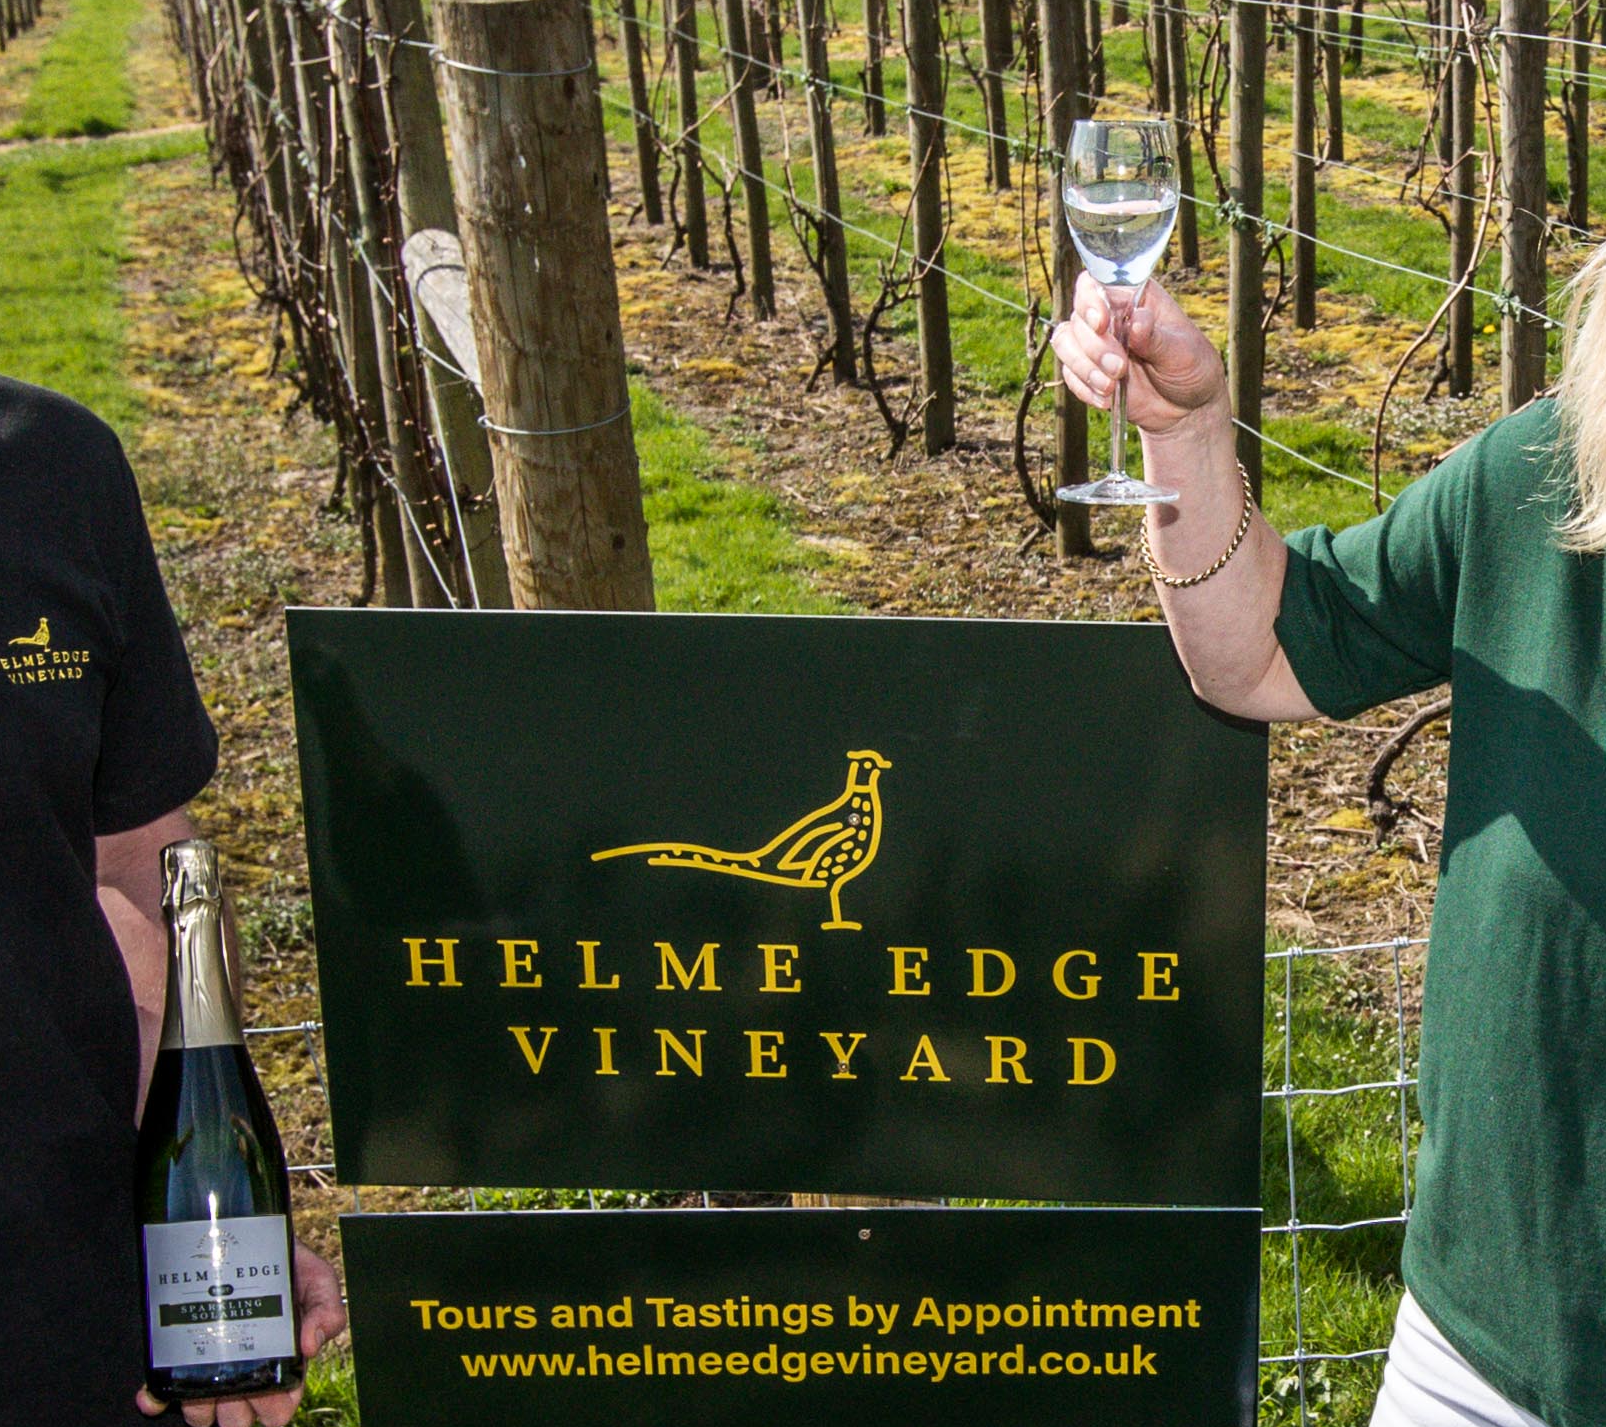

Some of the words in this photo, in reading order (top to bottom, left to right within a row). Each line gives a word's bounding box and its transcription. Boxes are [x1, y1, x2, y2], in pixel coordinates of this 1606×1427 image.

[53, 650, 90, 664] EDGE
[7, 667, 83, 685] VINEYARD
[403, 937, 802, 994] HELME
[888, 947, 1181, 1002] EDGE
[507, 1026, 1117, 1086] VINEYARD
[159, 1268, 219, 1285] HELM
[236, 1264, 281, 1279] EDGE
[180, 1299, 262, 1314] SPARKLING
[191, 1308, 253, 1321] SOLARIS
[409, 1299, 538, 1330] Tours
[550, 1295, 634, 1329] and
[645, 1295, 835, 1336] Tastings
[847, 1294, 900, 1335] by
[912, 1295, 1201, 1335] Appointment
[460, 1343, 1158, 1383] www.helmeedgevineyard.co.uk
